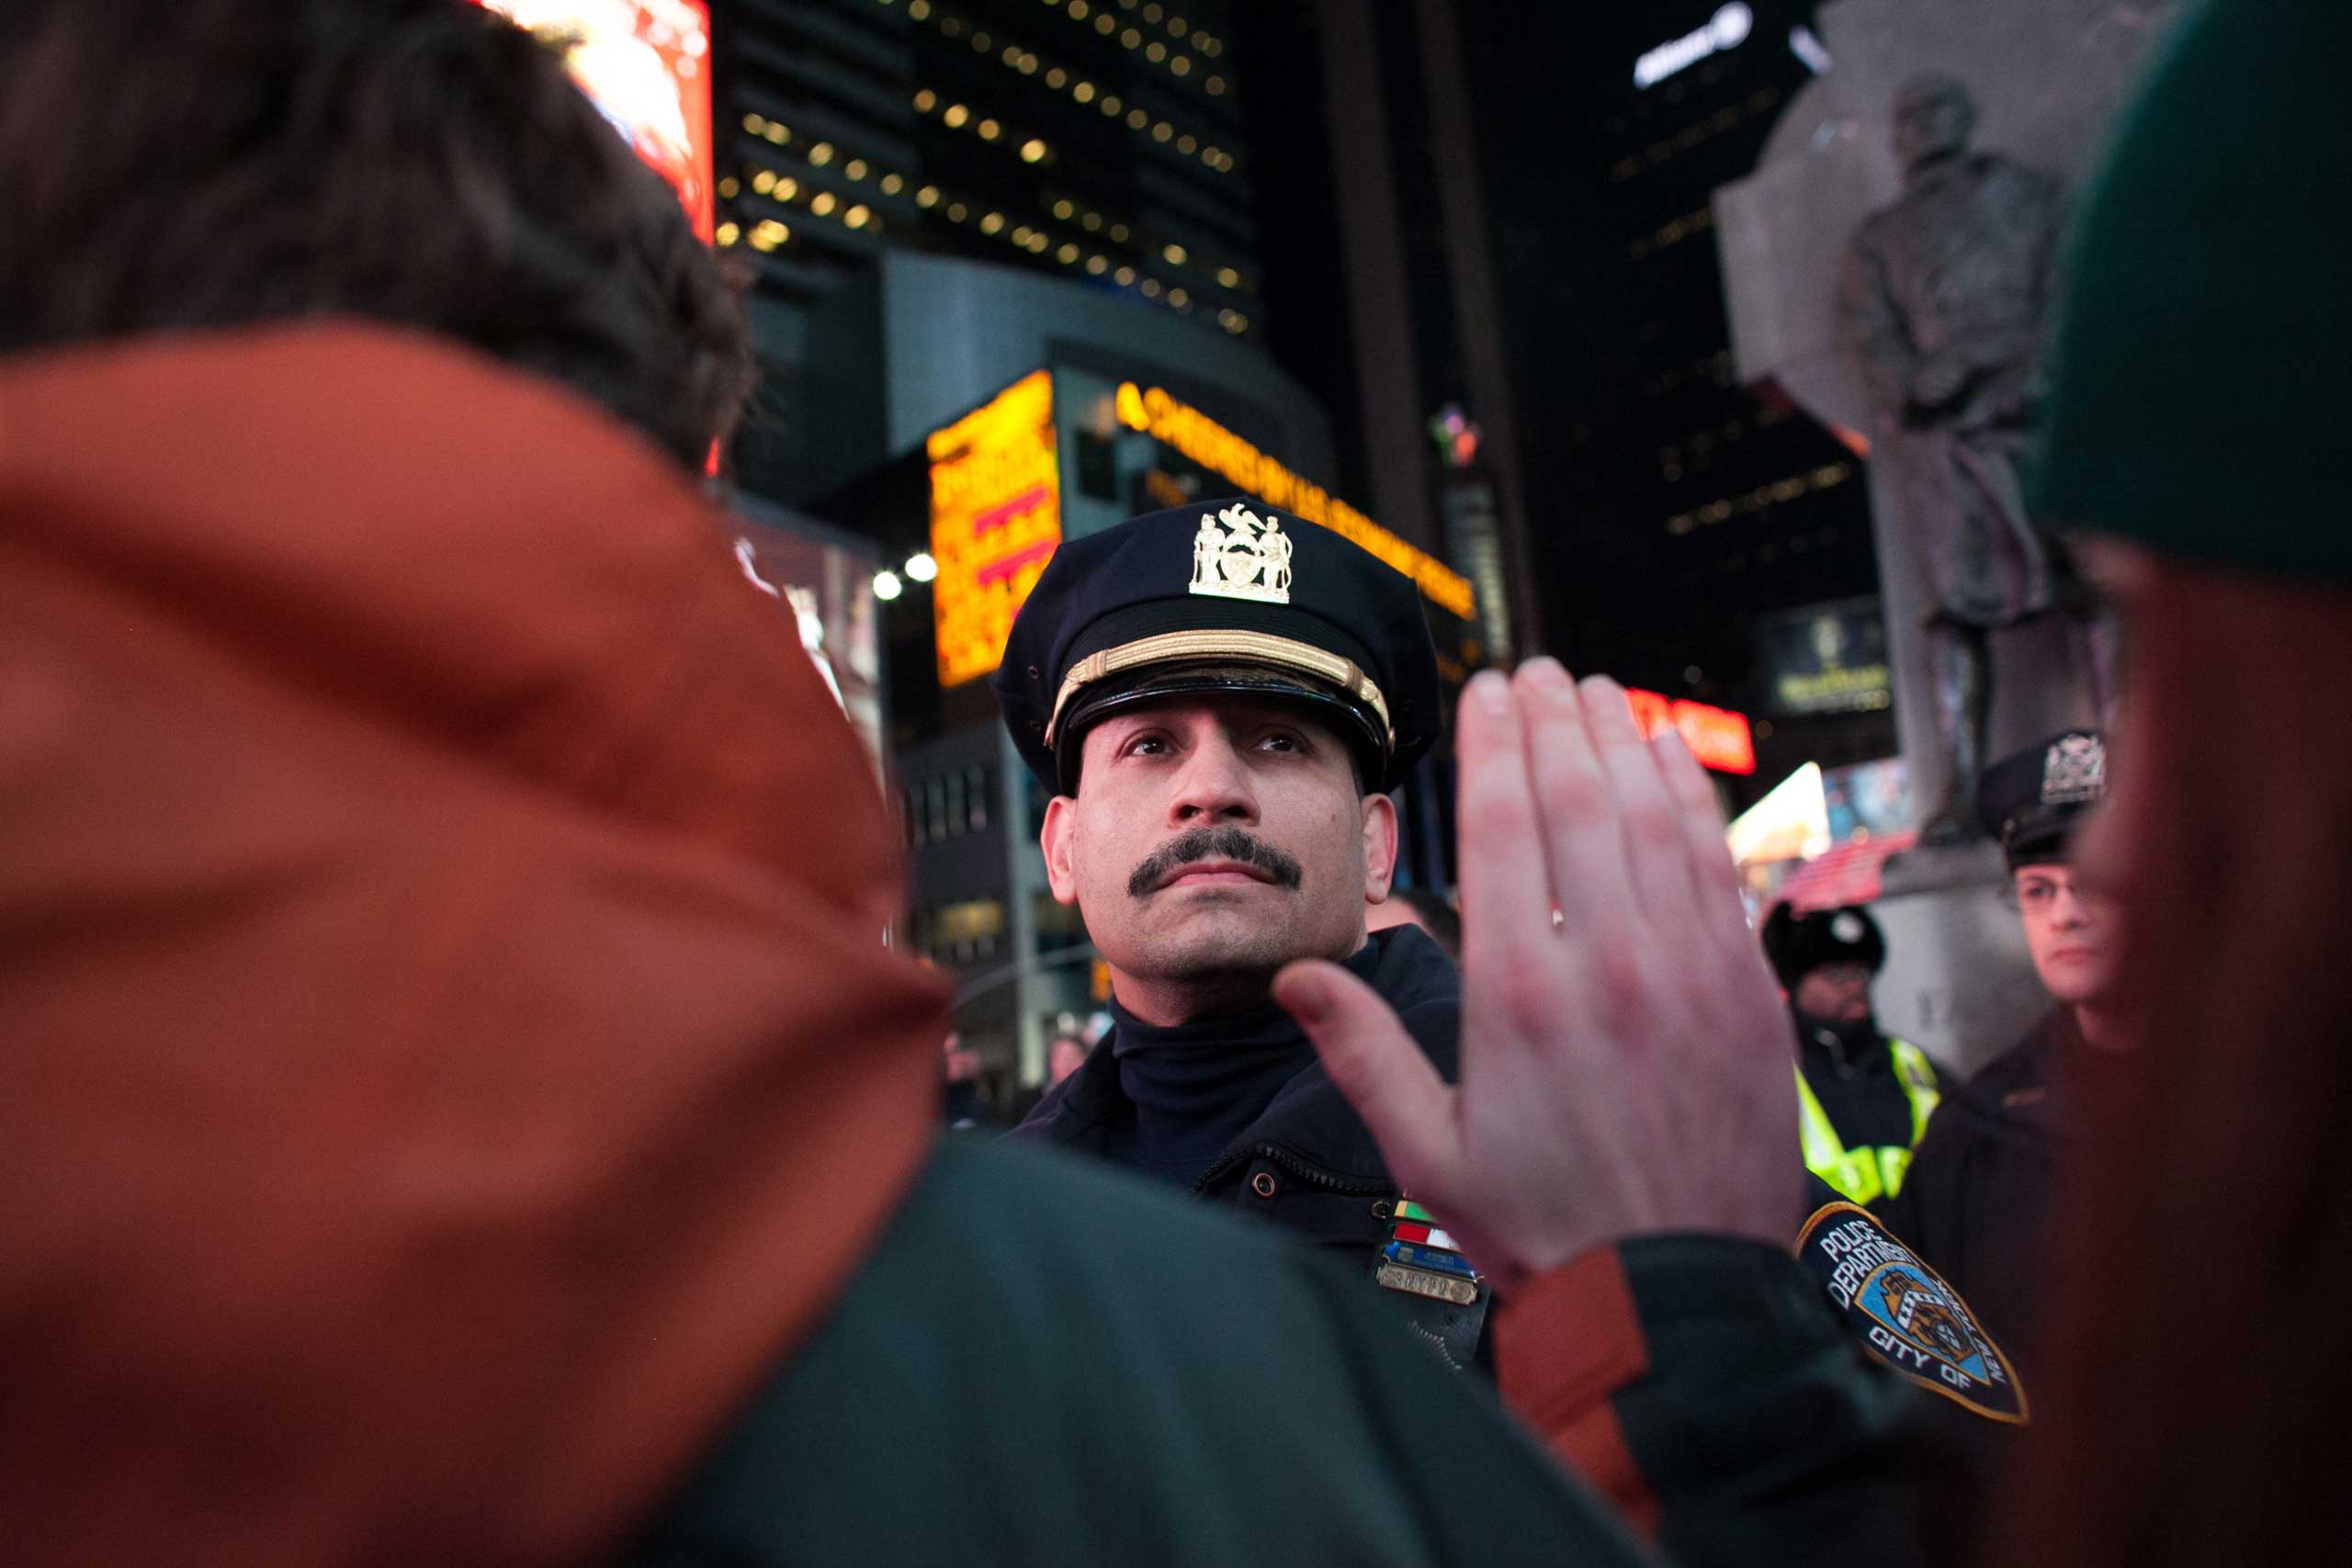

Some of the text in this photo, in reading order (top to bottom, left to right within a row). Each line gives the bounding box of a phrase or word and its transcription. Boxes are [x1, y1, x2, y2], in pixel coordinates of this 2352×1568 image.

[1820, 1220, 1883, 1263] POLICE
[1826, 1240, 1919, 1311] DEPARTMENT
[1869, 1325, 1972, 1390] CITY OF
